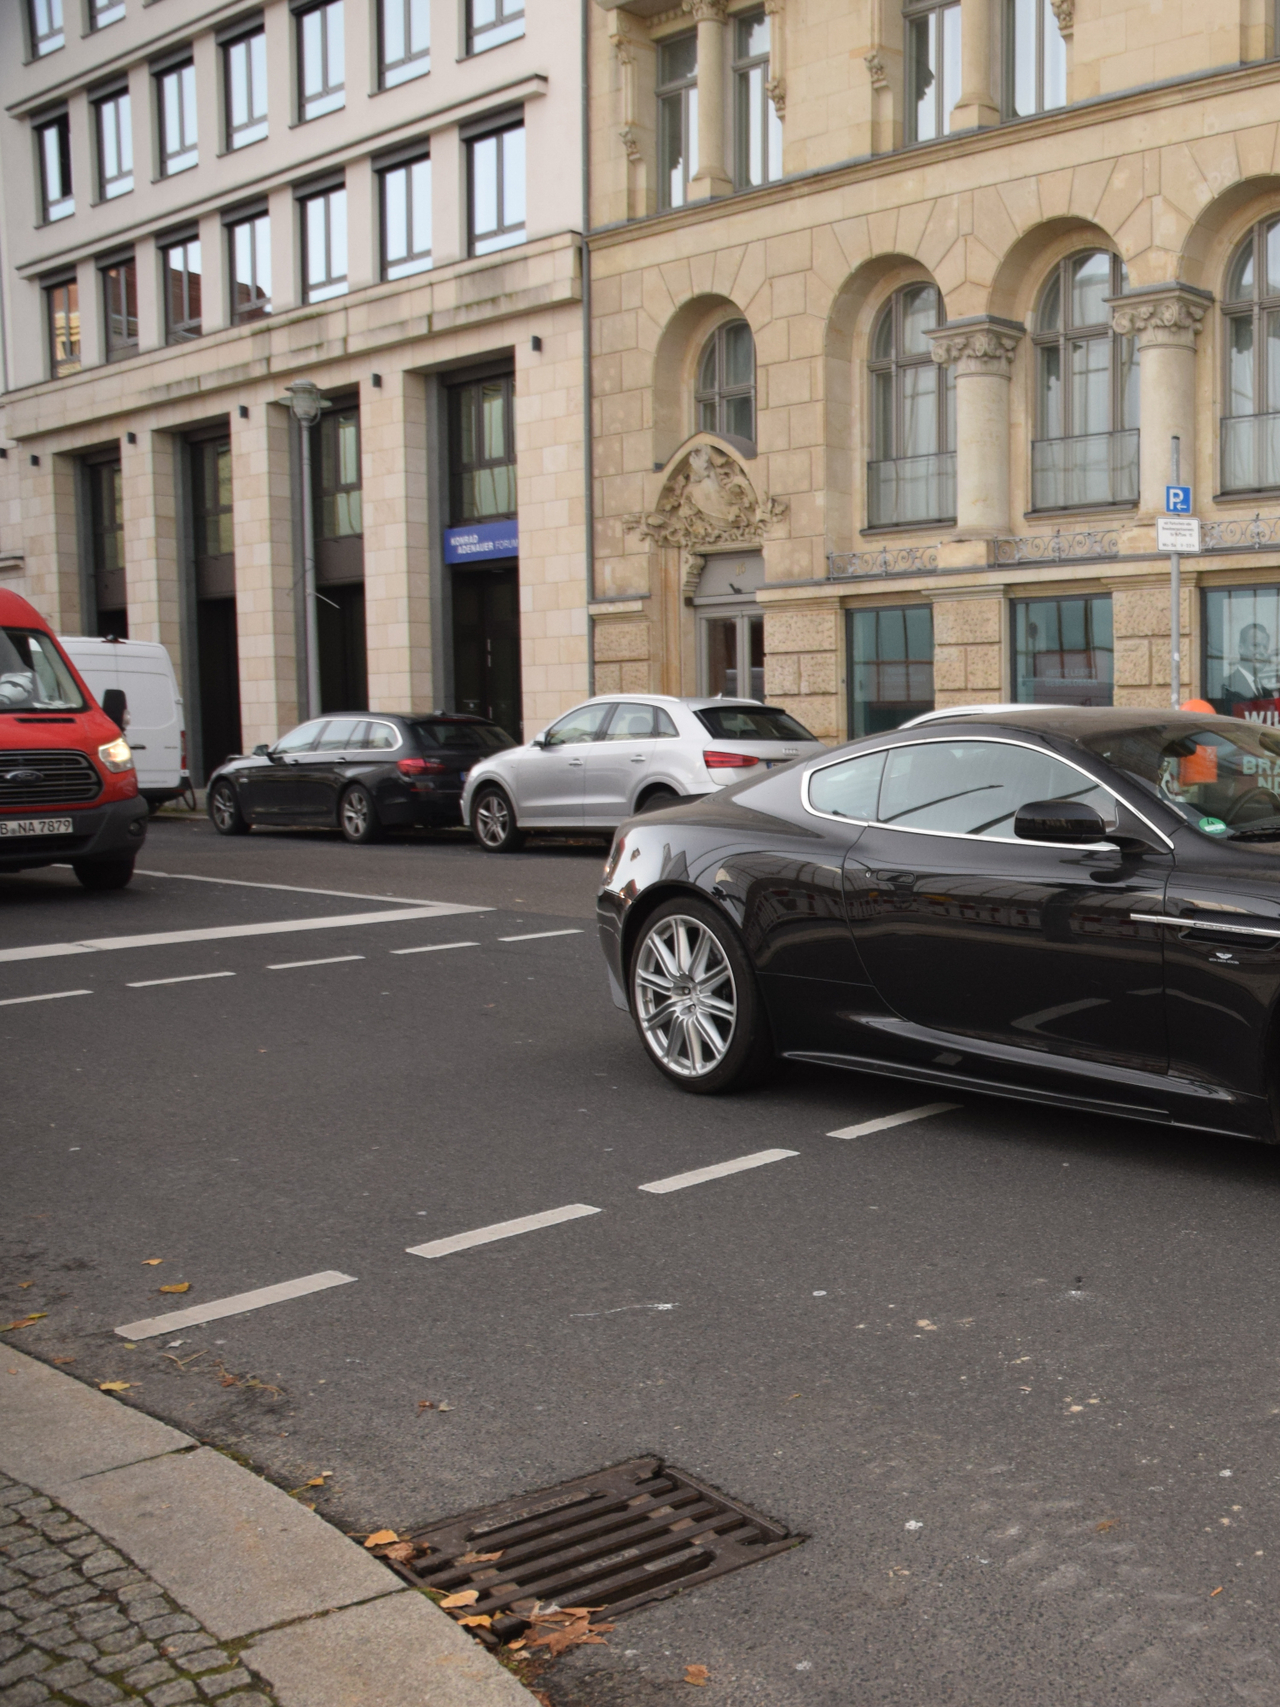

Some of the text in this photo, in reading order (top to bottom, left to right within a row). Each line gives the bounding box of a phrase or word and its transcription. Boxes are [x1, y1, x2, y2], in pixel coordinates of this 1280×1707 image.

[1169, 489, 1184, 510] P
[450, 534, 479, 546] KONRAD
[457, 541, 494, 554] ADENAUER
[17, 822, 36, 834] NA
[38, 819, 71, 833] 7879
